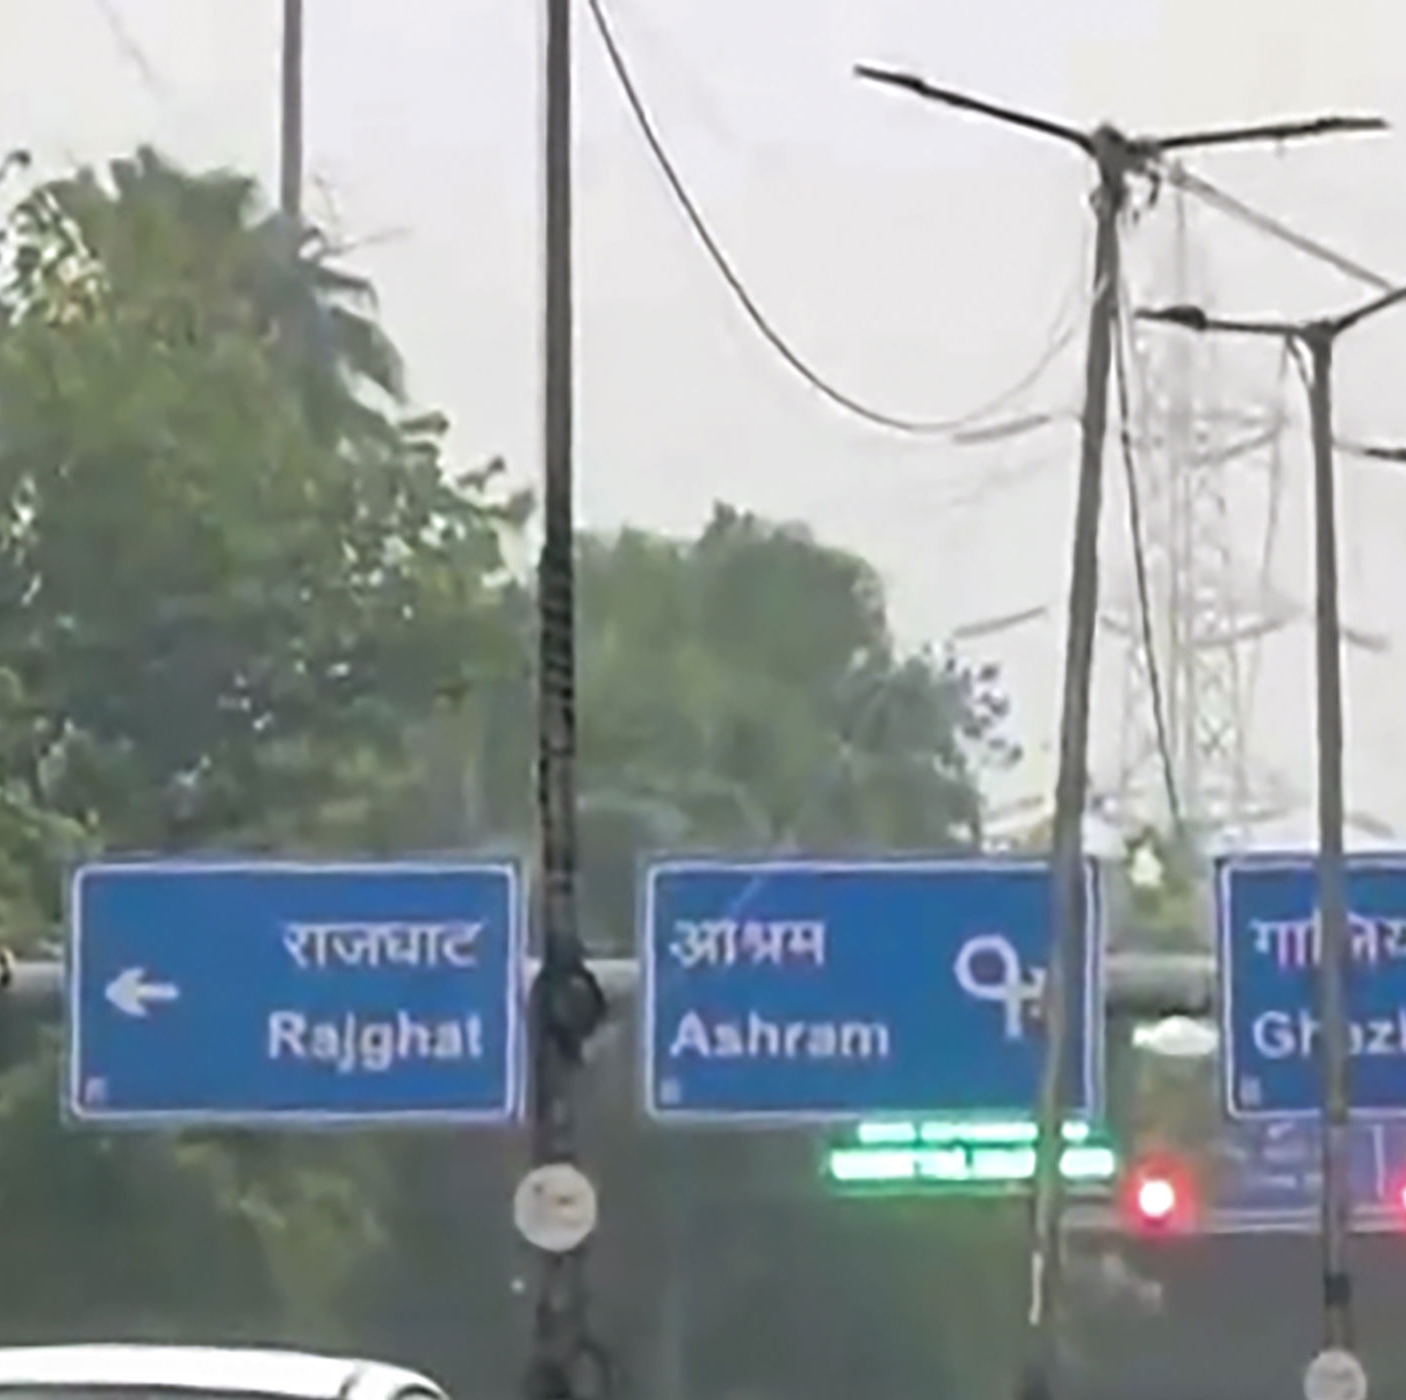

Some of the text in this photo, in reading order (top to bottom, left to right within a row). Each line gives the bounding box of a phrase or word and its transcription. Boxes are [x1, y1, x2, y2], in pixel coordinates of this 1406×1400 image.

[282, 919, 484, 968] राजघाट
[669, 918, 826, 968] आश्रम
[267, 1008, 483, 1073] Rajghat
[668, 1009, 890, 1059] Ashram
